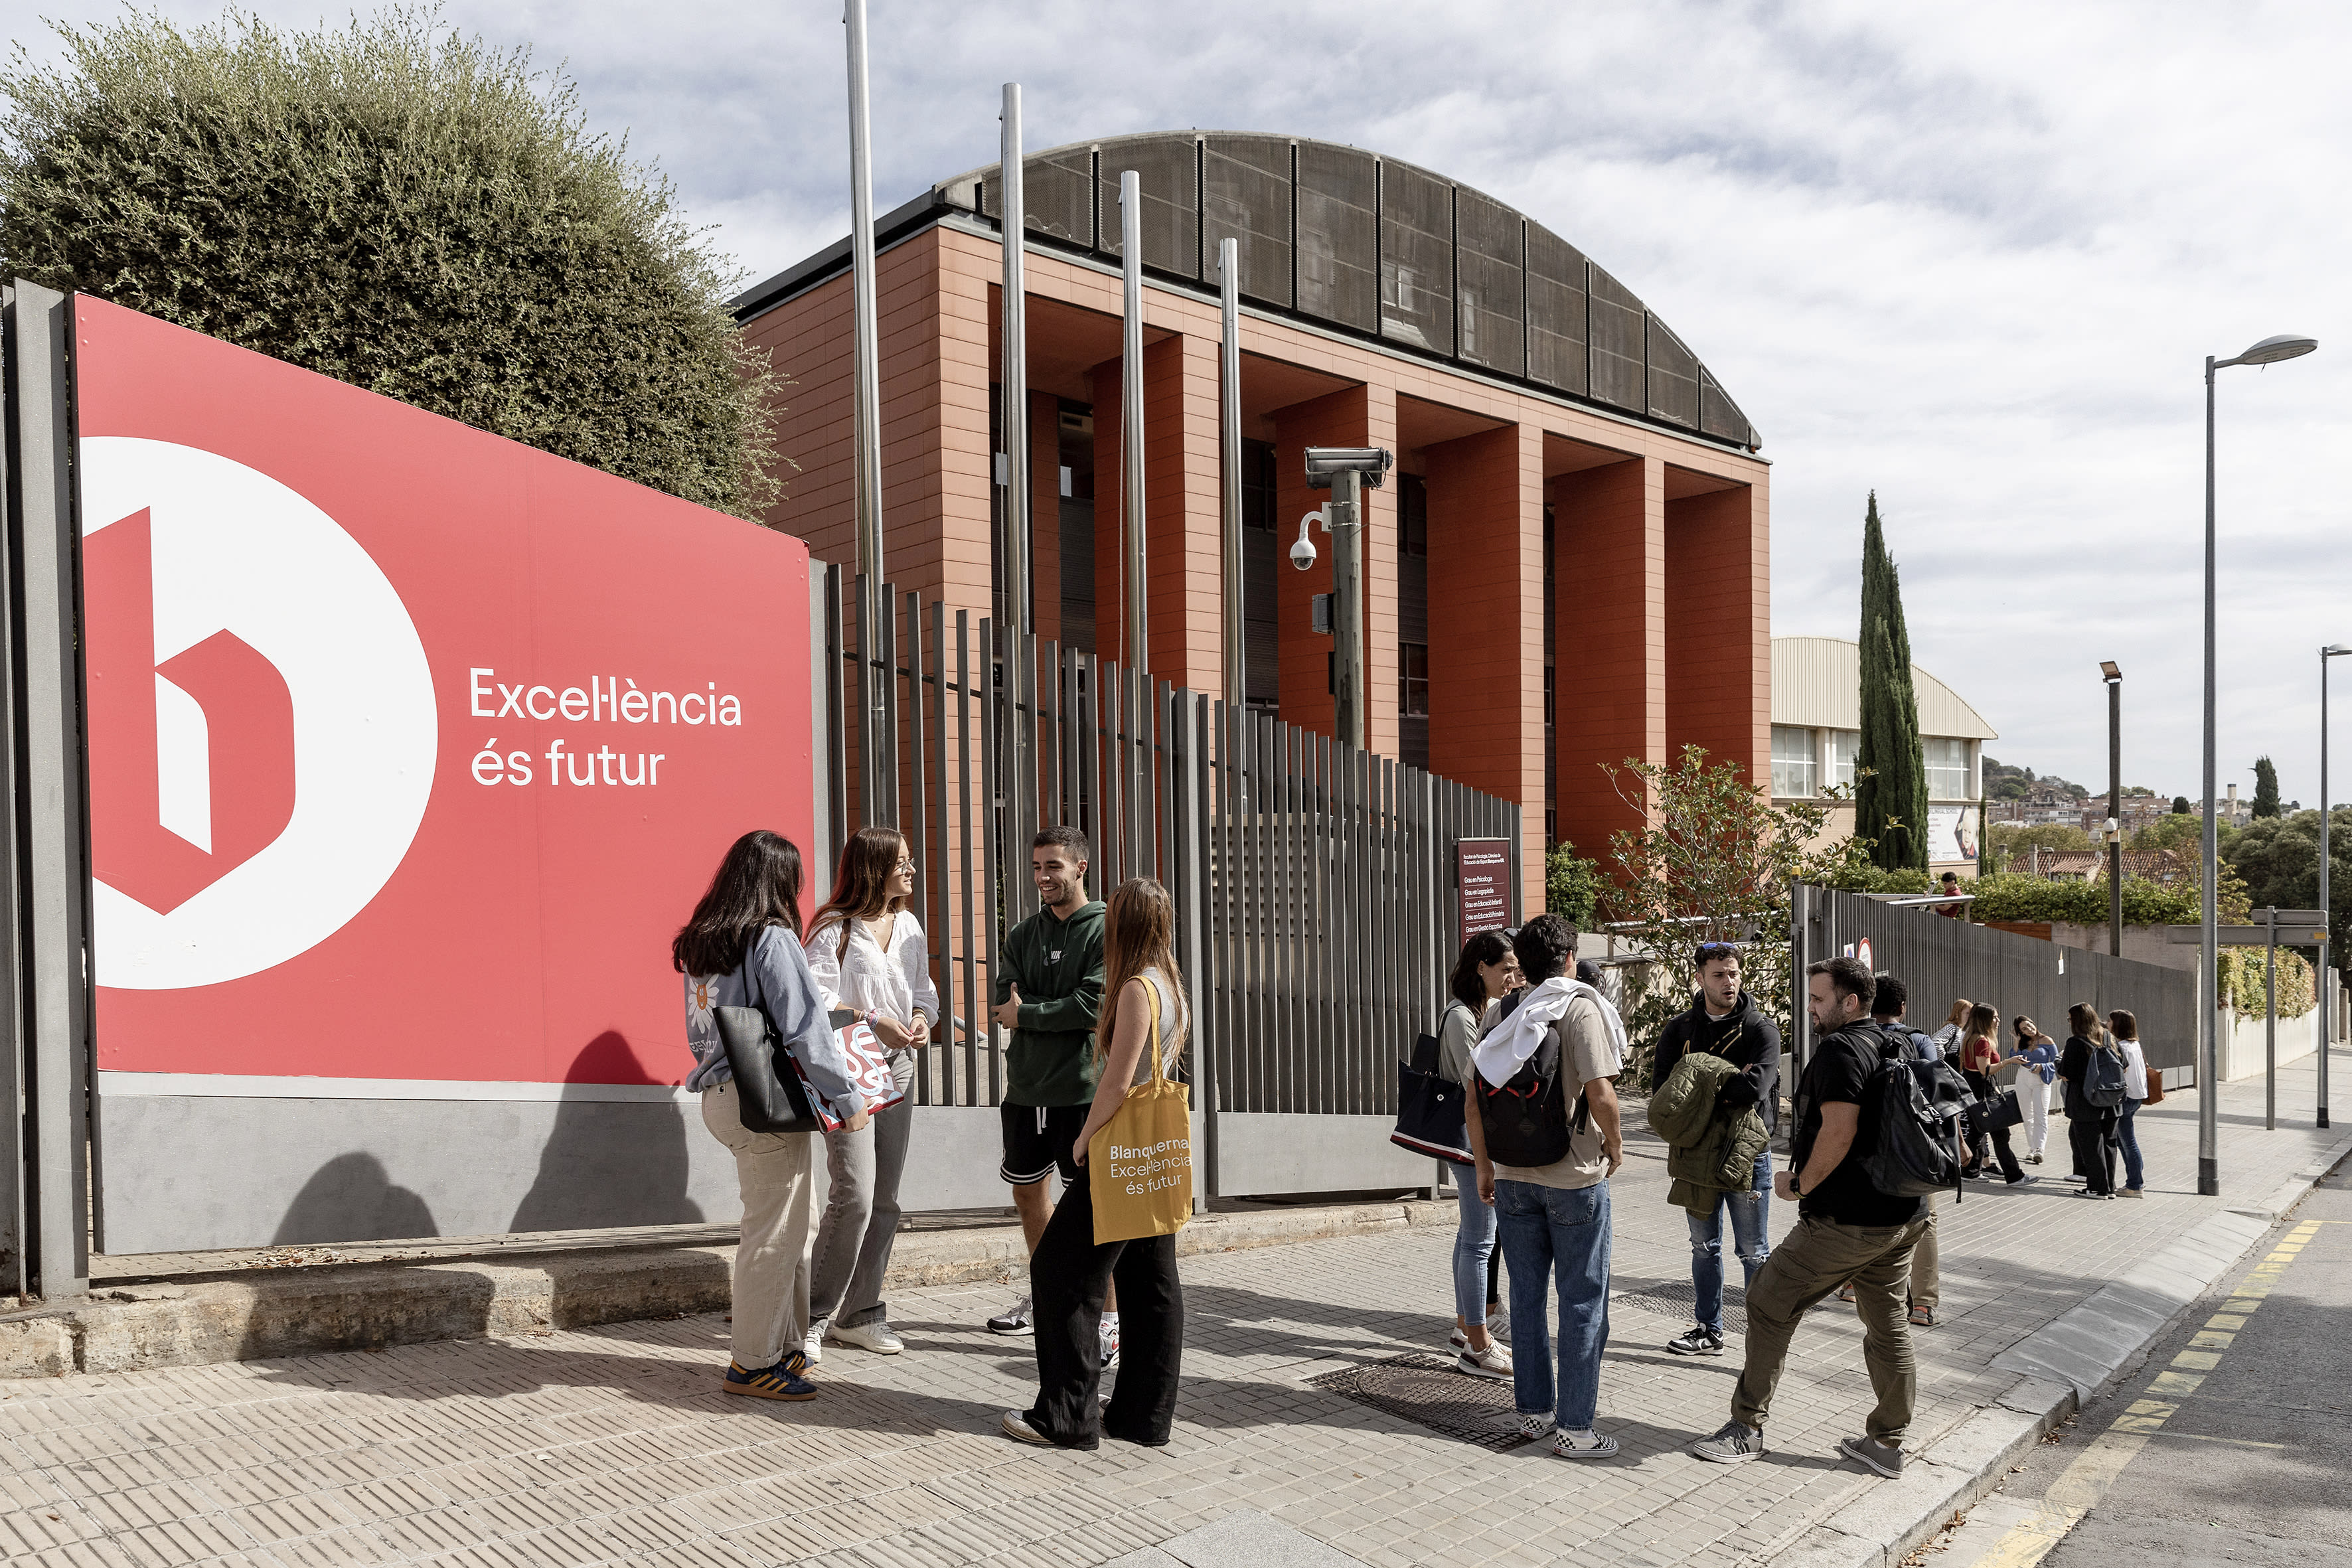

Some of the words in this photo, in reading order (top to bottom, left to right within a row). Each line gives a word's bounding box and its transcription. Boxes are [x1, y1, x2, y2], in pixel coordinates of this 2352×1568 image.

[469, 666, 742, 726] Excel·lència
[471, 738, 532, 787] és
[545, 738, 665, 787] futur
[1051, 950, 1062, 959] NIK
[1109, 1138, 1190, 1160] Blanquerna
[1111, 1153, 1192, 1178] Excel·lència
[1125, 1181, 1144, 1195] és
[1147, 1174, 1182, 1193] futur
